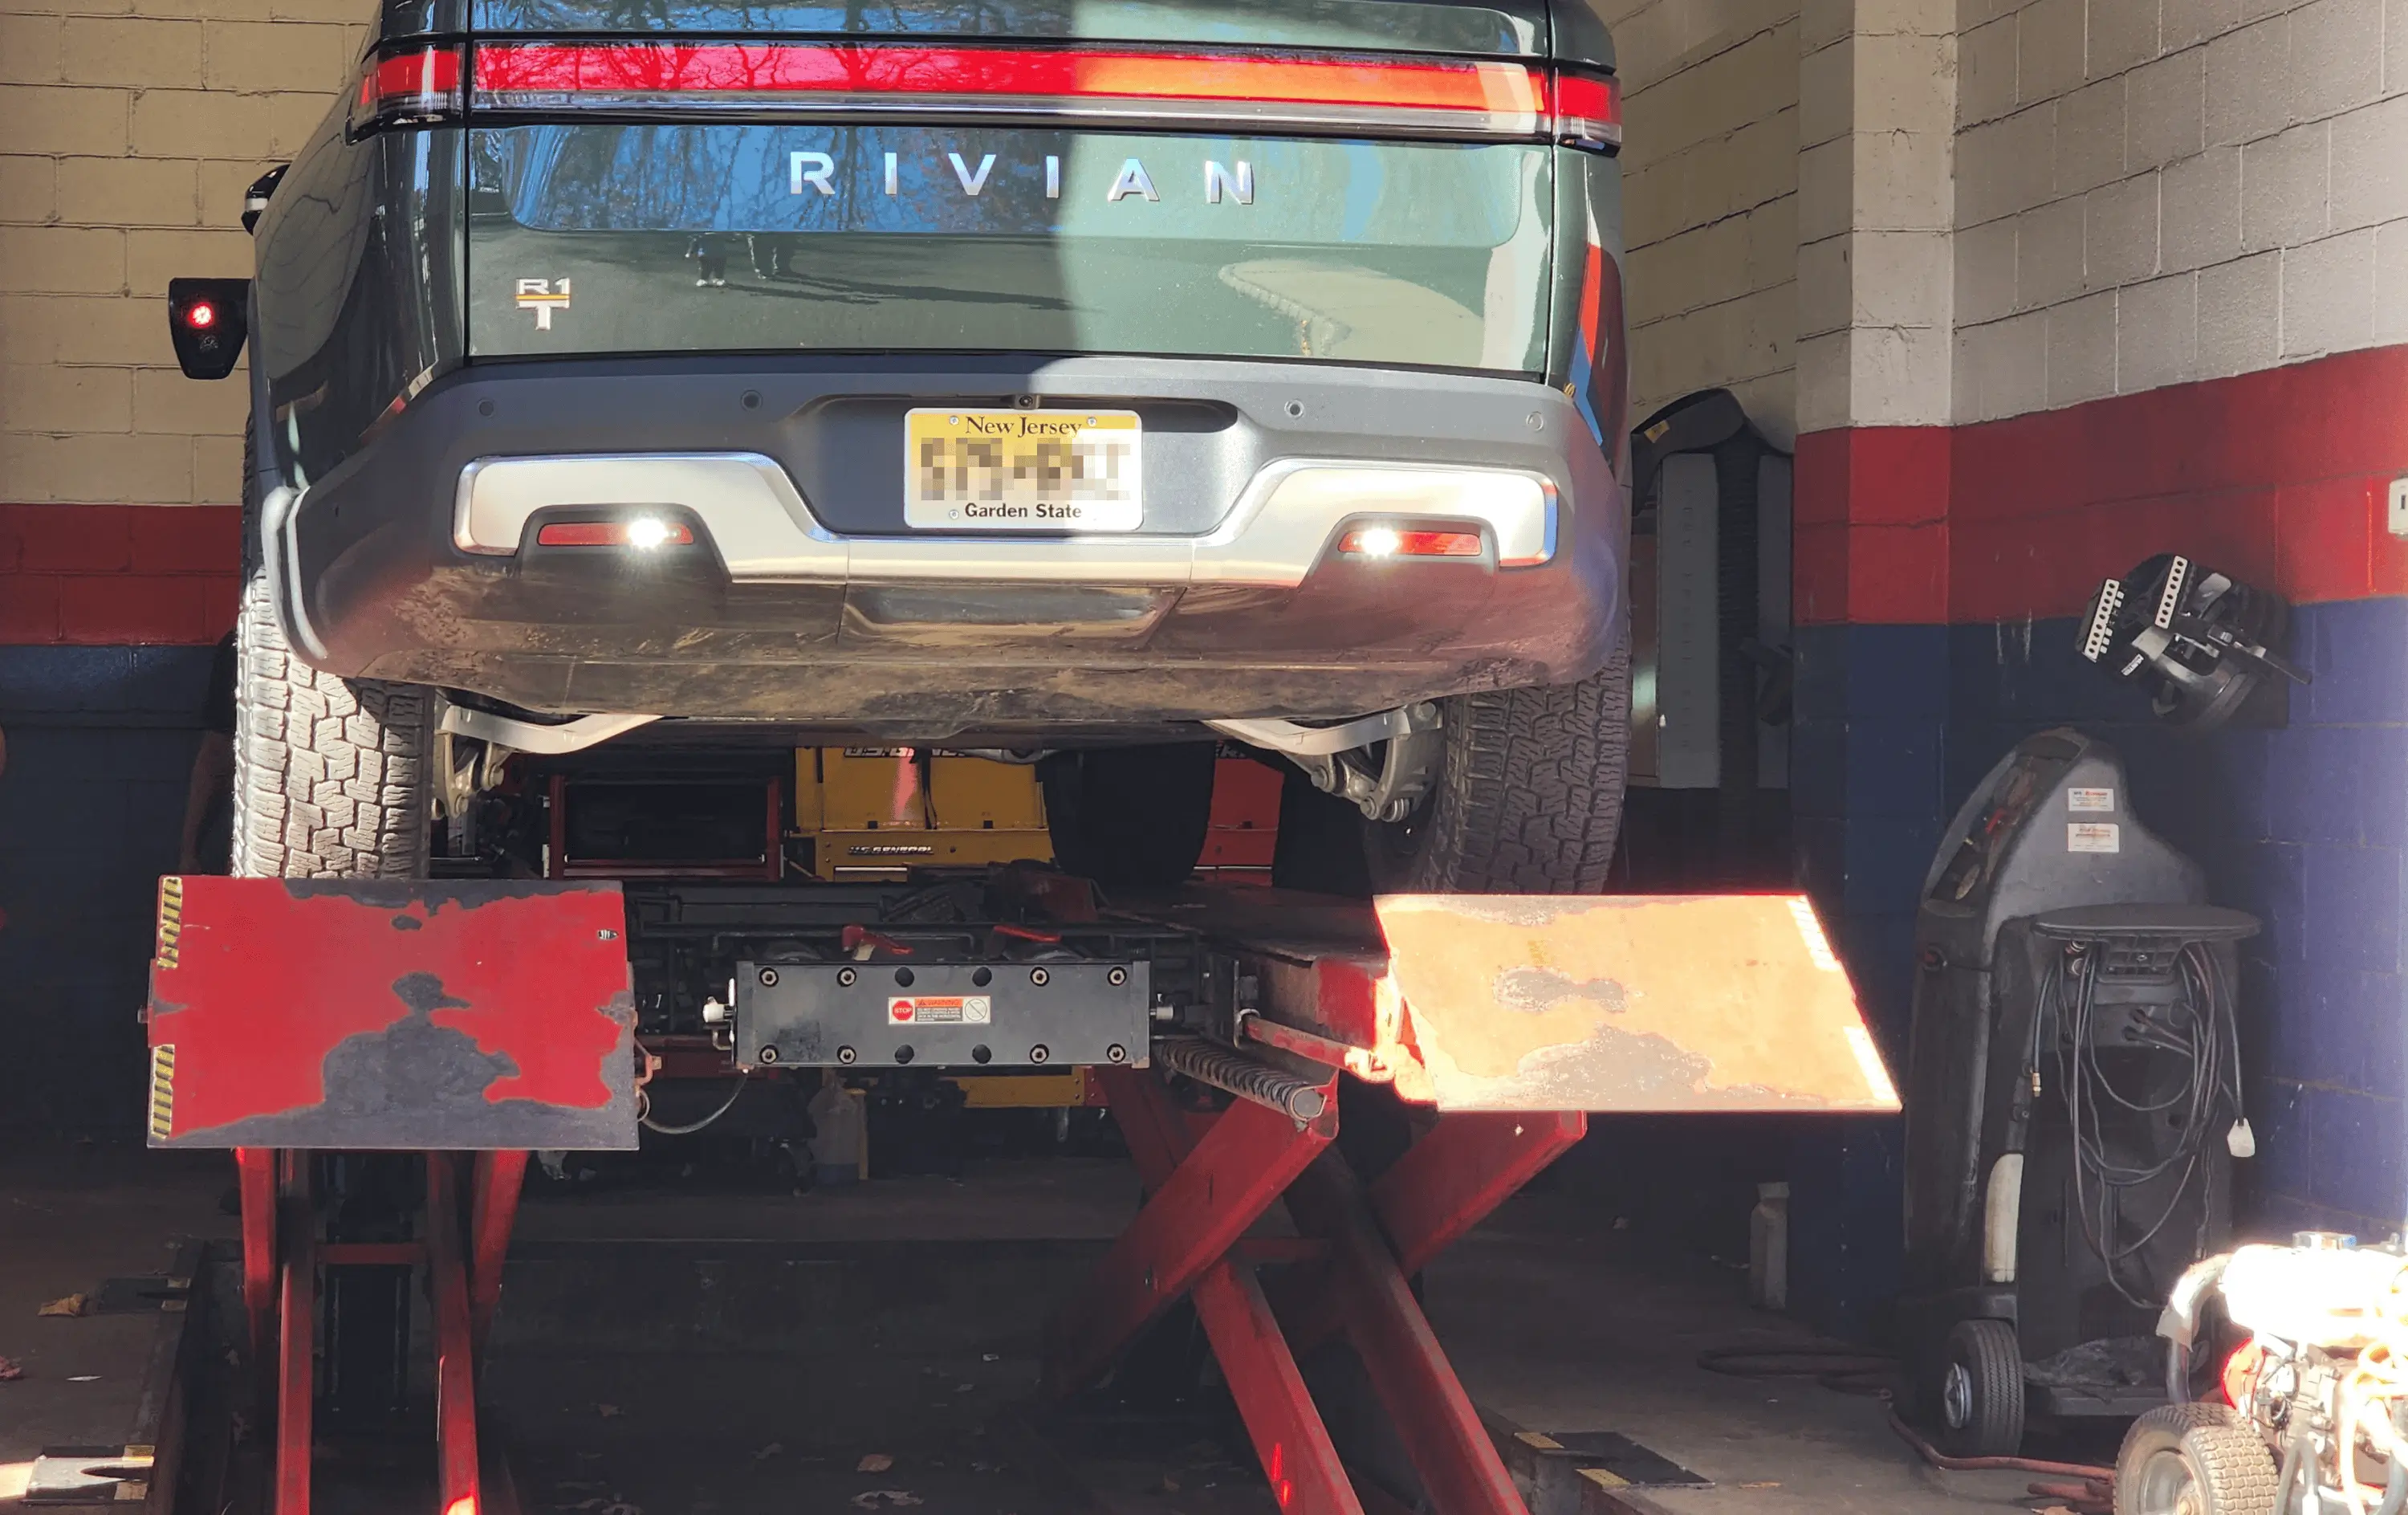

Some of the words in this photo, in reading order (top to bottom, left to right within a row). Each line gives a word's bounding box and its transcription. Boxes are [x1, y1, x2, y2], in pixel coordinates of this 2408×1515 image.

[790, 152, 1254, 205] RIVIAN
[966, 416, 1015, 434] New
[1018, 416, 1083, 438] Jersey
[965, 503, 1028, 517] Garden
[1035, 503, 1082, 518] State
